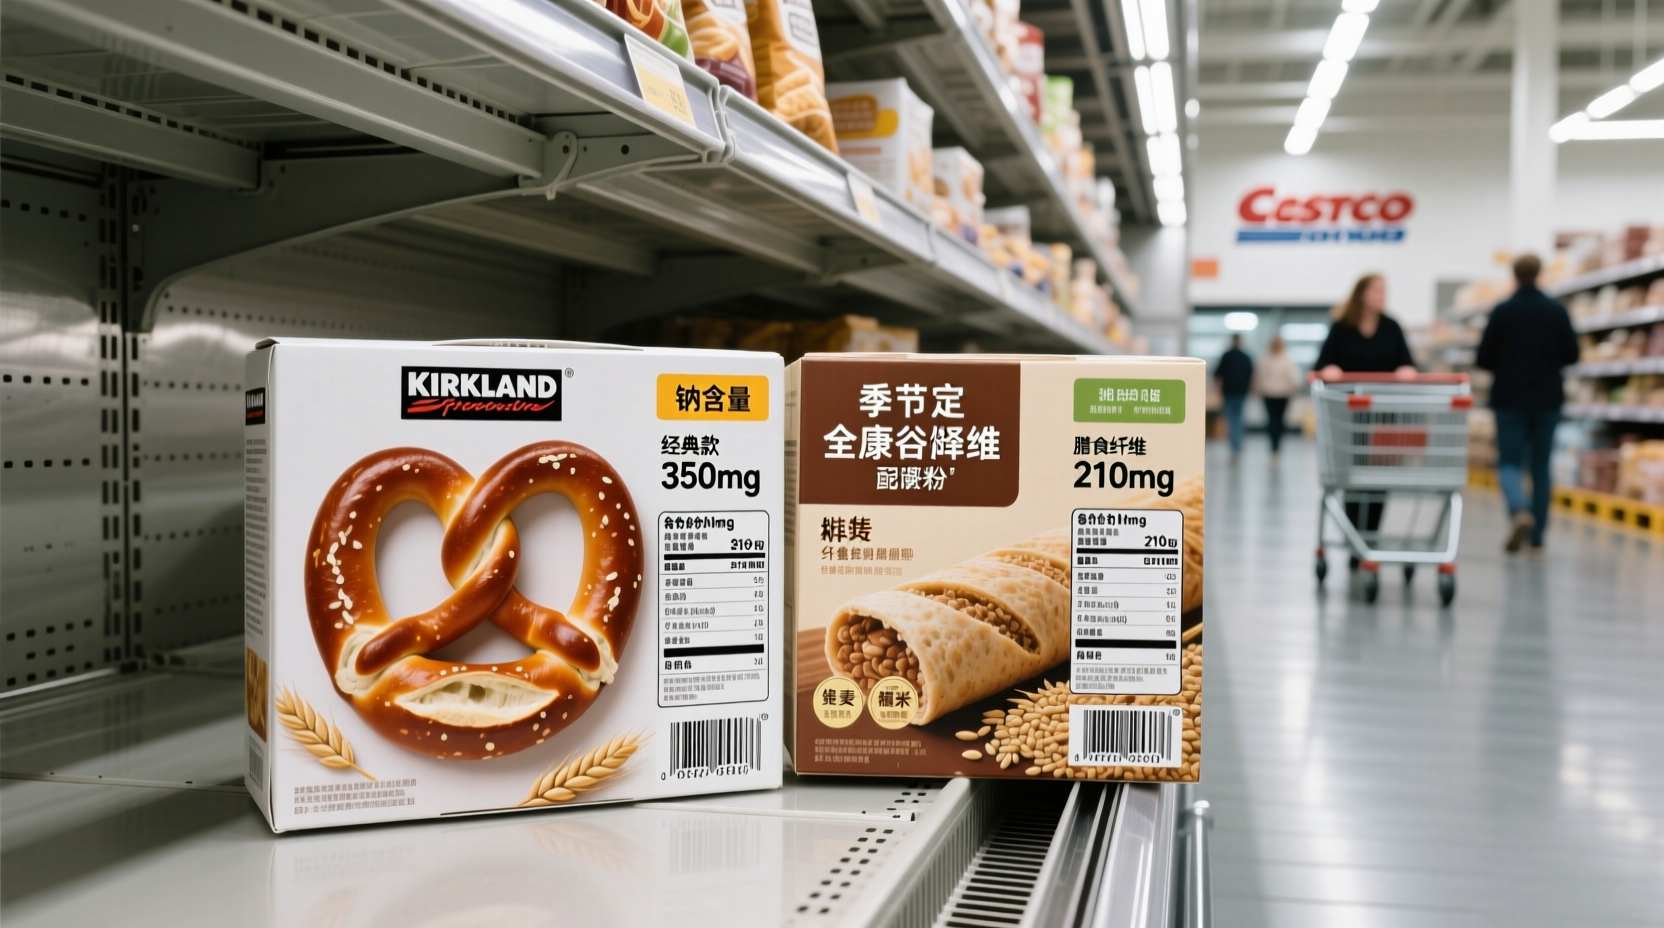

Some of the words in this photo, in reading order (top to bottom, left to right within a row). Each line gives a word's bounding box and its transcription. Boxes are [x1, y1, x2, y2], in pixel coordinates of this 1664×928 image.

[408, 371, 557, 398] KIRKLAND
[675, 384, 750, 412] 钠含量
[859, 383, 964, 418] 季节定
[661, 433, 720, 456] 经典款
[661, 461, 760, 497] 350mg
[1073, 460, 1174, 497] 210mg
